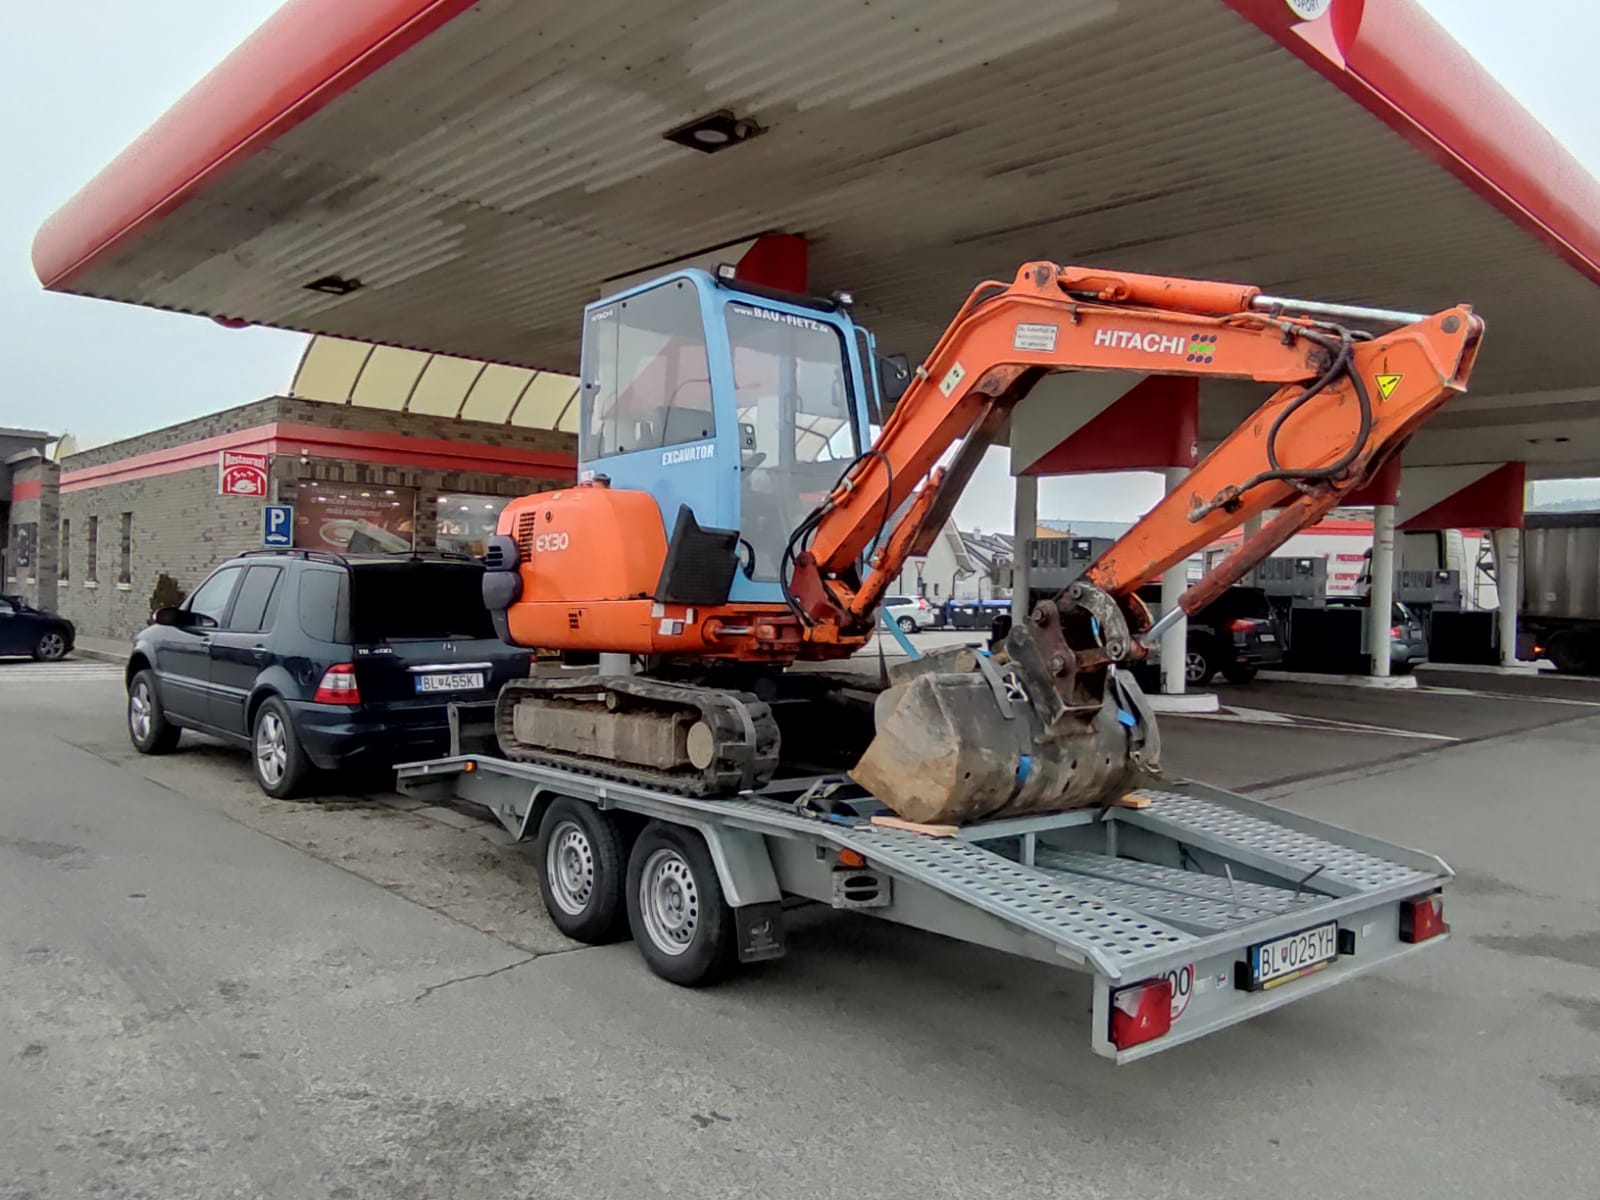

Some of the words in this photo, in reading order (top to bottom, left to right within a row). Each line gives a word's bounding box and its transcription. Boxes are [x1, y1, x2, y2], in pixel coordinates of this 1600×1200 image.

[1094, 329, 1185, 354] HITACHI
[662, 444, 714, 466] EXCAVATOR
[270, 508, 285, 532] P
[535, 532, 569, 552] EX30
[1262, 945, 1280, 977] BL
